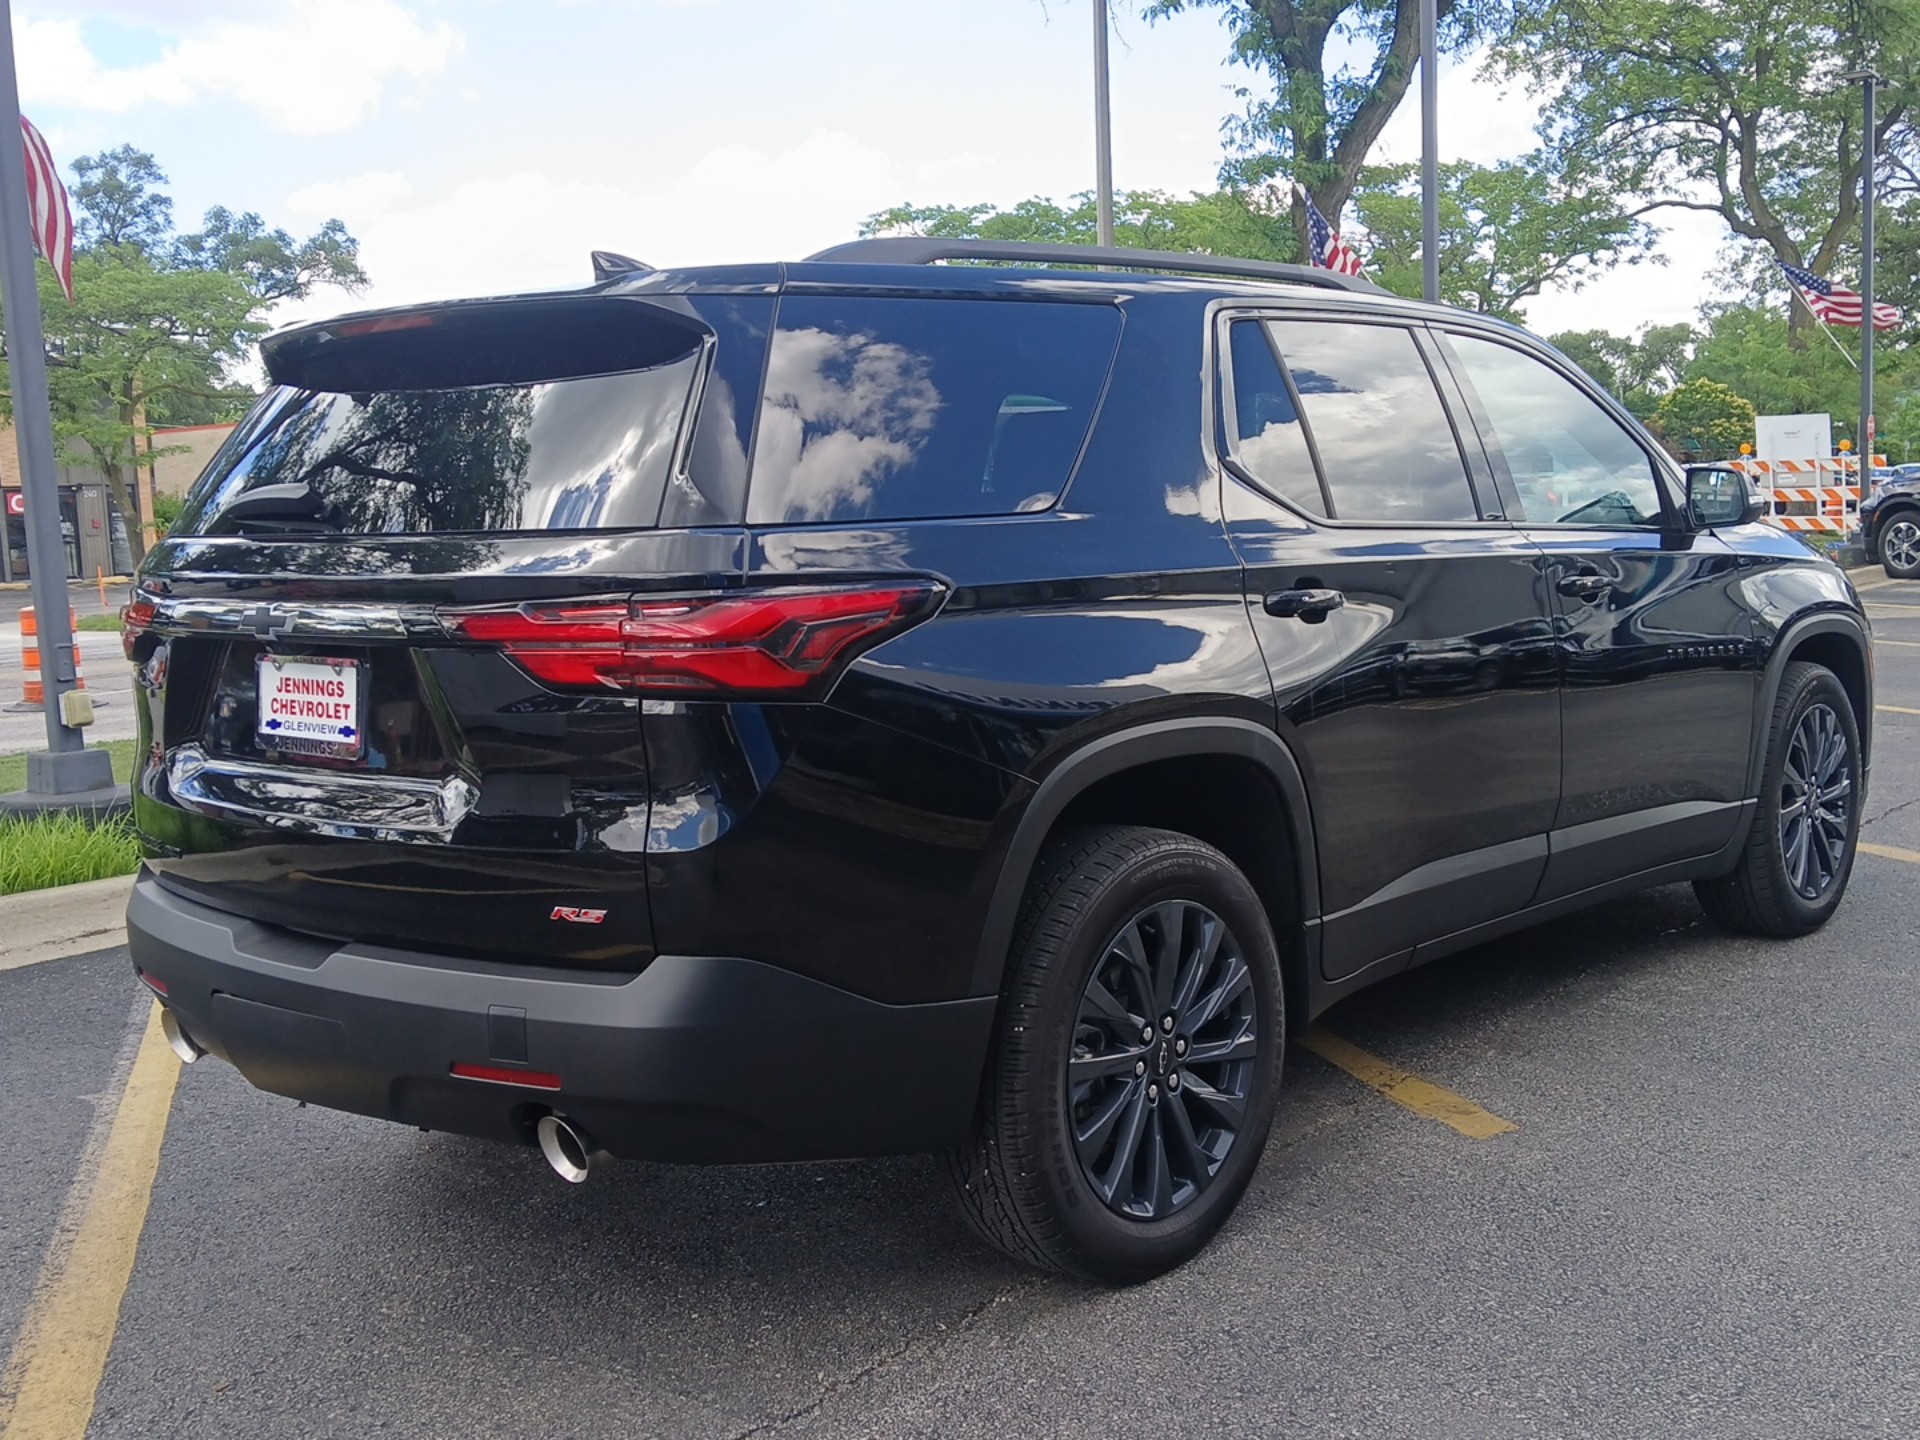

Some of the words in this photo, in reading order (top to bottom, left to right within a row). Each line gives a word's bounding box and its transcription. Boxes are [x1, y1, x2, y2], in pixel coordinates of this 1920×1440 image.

[83, 490, 98, 498] 240
[1667, 643, 1745, 659] TRAVERSE
[276, 677, 345, 697] JENNINGS
[271, 698, 351, 720] CHEVROLET
[283, 720, 338, 735] GLENVIEW
[279, 737, 334, 756] JENNINGS
[549, 906, 608, 924] RS
